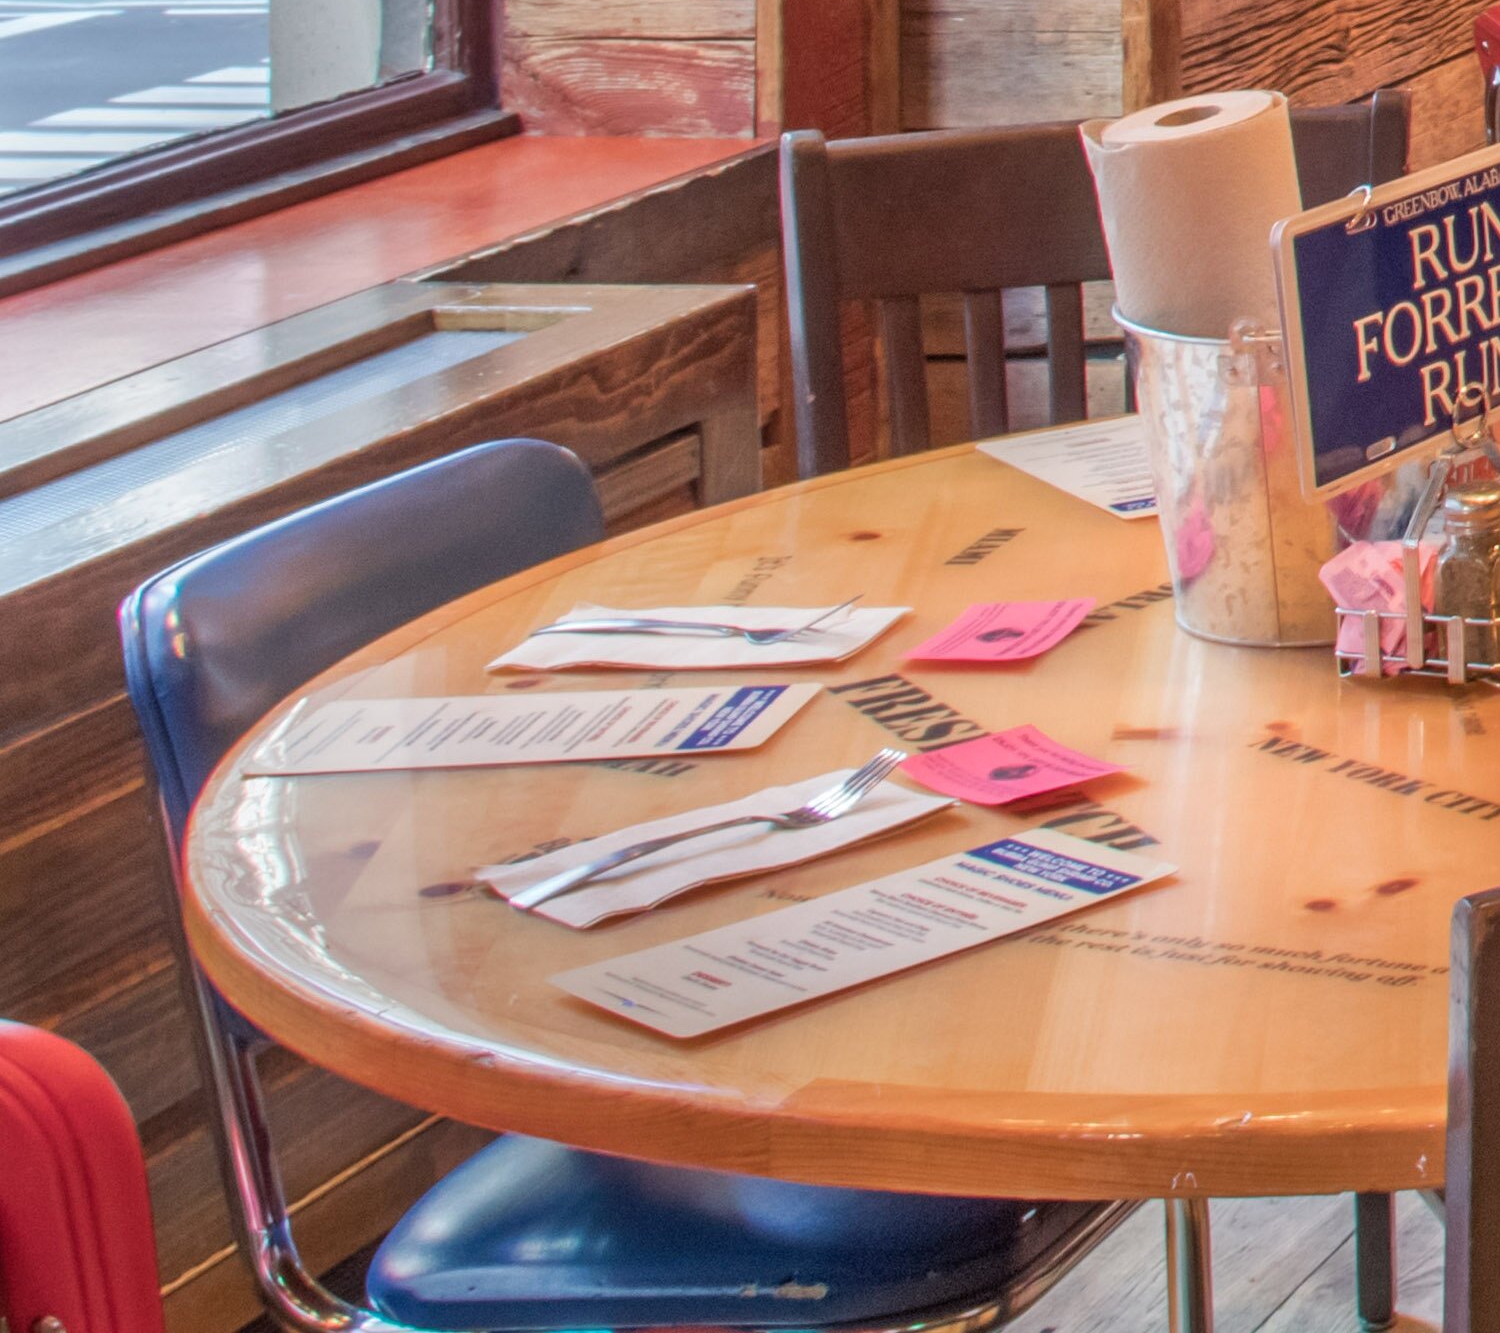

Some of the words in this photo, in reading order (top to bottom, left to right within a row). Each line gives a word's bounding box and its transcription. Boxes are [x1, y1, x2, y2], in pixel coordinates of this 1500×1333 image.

[1057, 921, 1146, 943] there's
[1074, 939, 1129, 954] rest
[1257, 960, 1377, 986] showing
